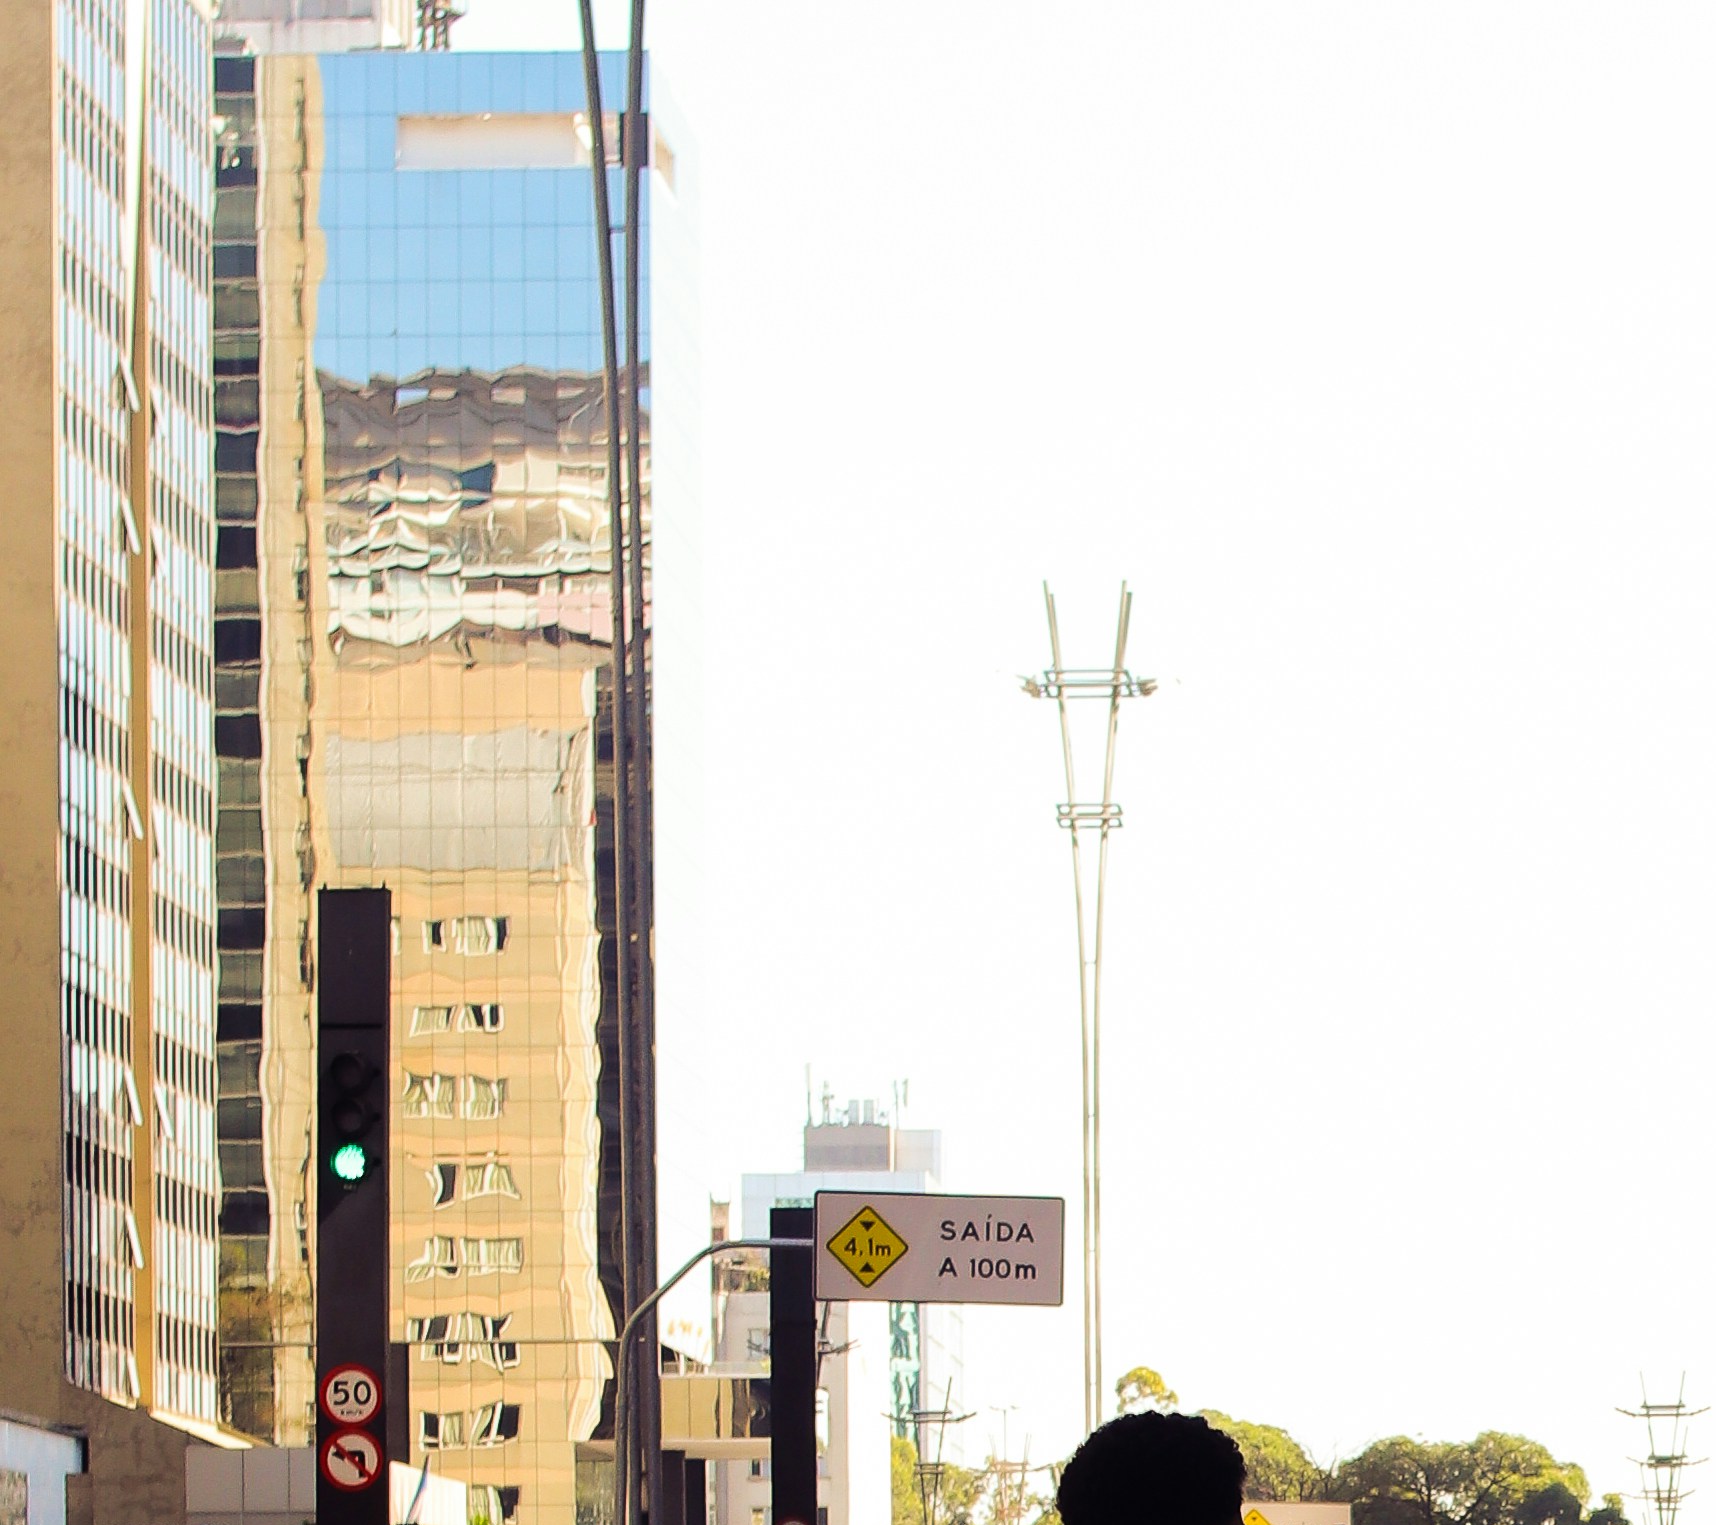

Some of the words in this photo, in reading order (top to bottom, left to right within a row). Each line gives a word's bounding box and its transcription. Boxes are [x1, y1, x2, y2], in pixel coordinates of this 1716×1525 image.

[940, 1214, 1035, 1243] SAÍDA
[843, 1238, 892, 1257] 4,1m
[938, 1257, 958, 1278] A
[970, 1258, 1037, 1280] 100m
[332, 1380, 372, 1405] 50
